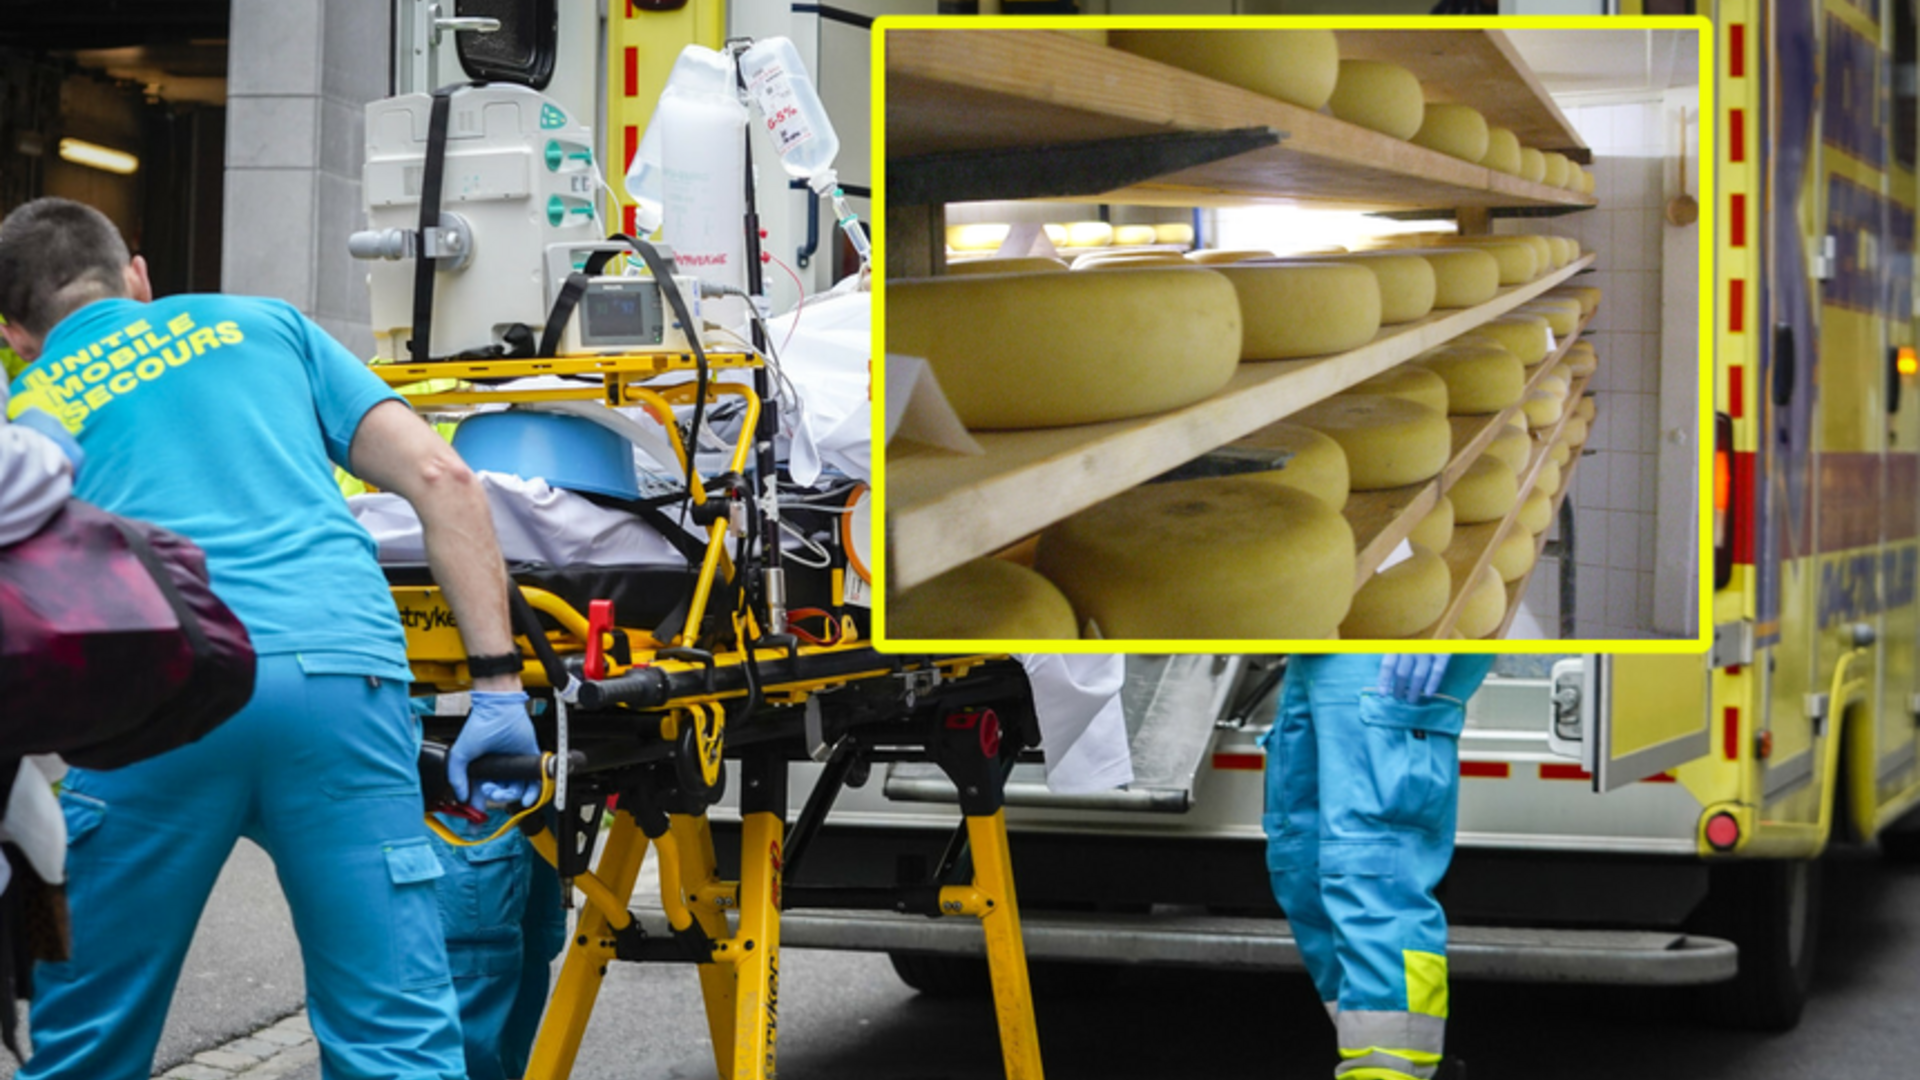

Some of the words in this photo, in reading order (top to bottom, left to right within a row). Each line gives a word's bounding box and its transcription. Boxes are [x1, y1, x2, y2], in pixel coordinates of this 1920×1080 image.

[33, 318, 152, 387] UNITE
[46, 312, 196, 409] MOBILE
[63, 320, 244, 426] SECOURS
